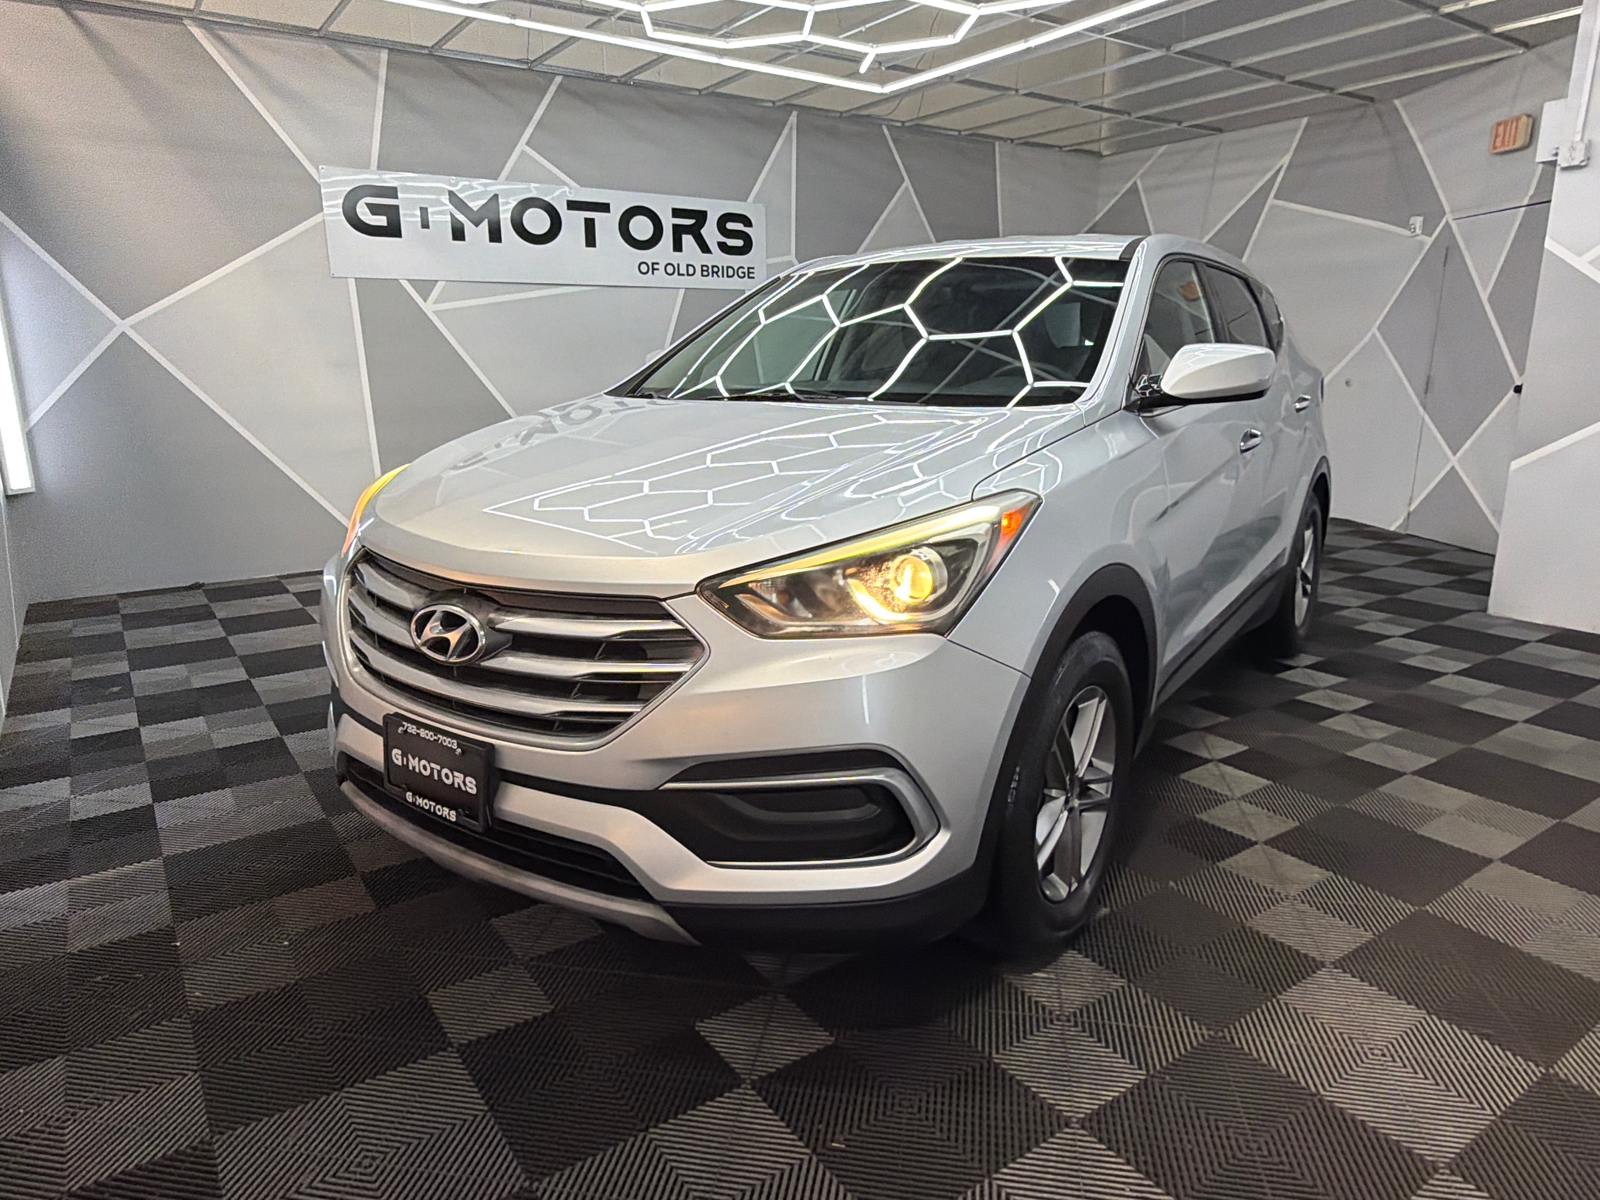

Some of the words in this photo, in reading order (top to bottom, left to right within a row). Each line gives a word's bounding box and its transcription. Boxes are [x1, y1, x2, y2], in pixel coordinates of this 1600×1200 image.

[637, 261, 660, 276] OF
[663, 262, 697, 277] OLD
[700, 264, 756, 280] BRIDGE
